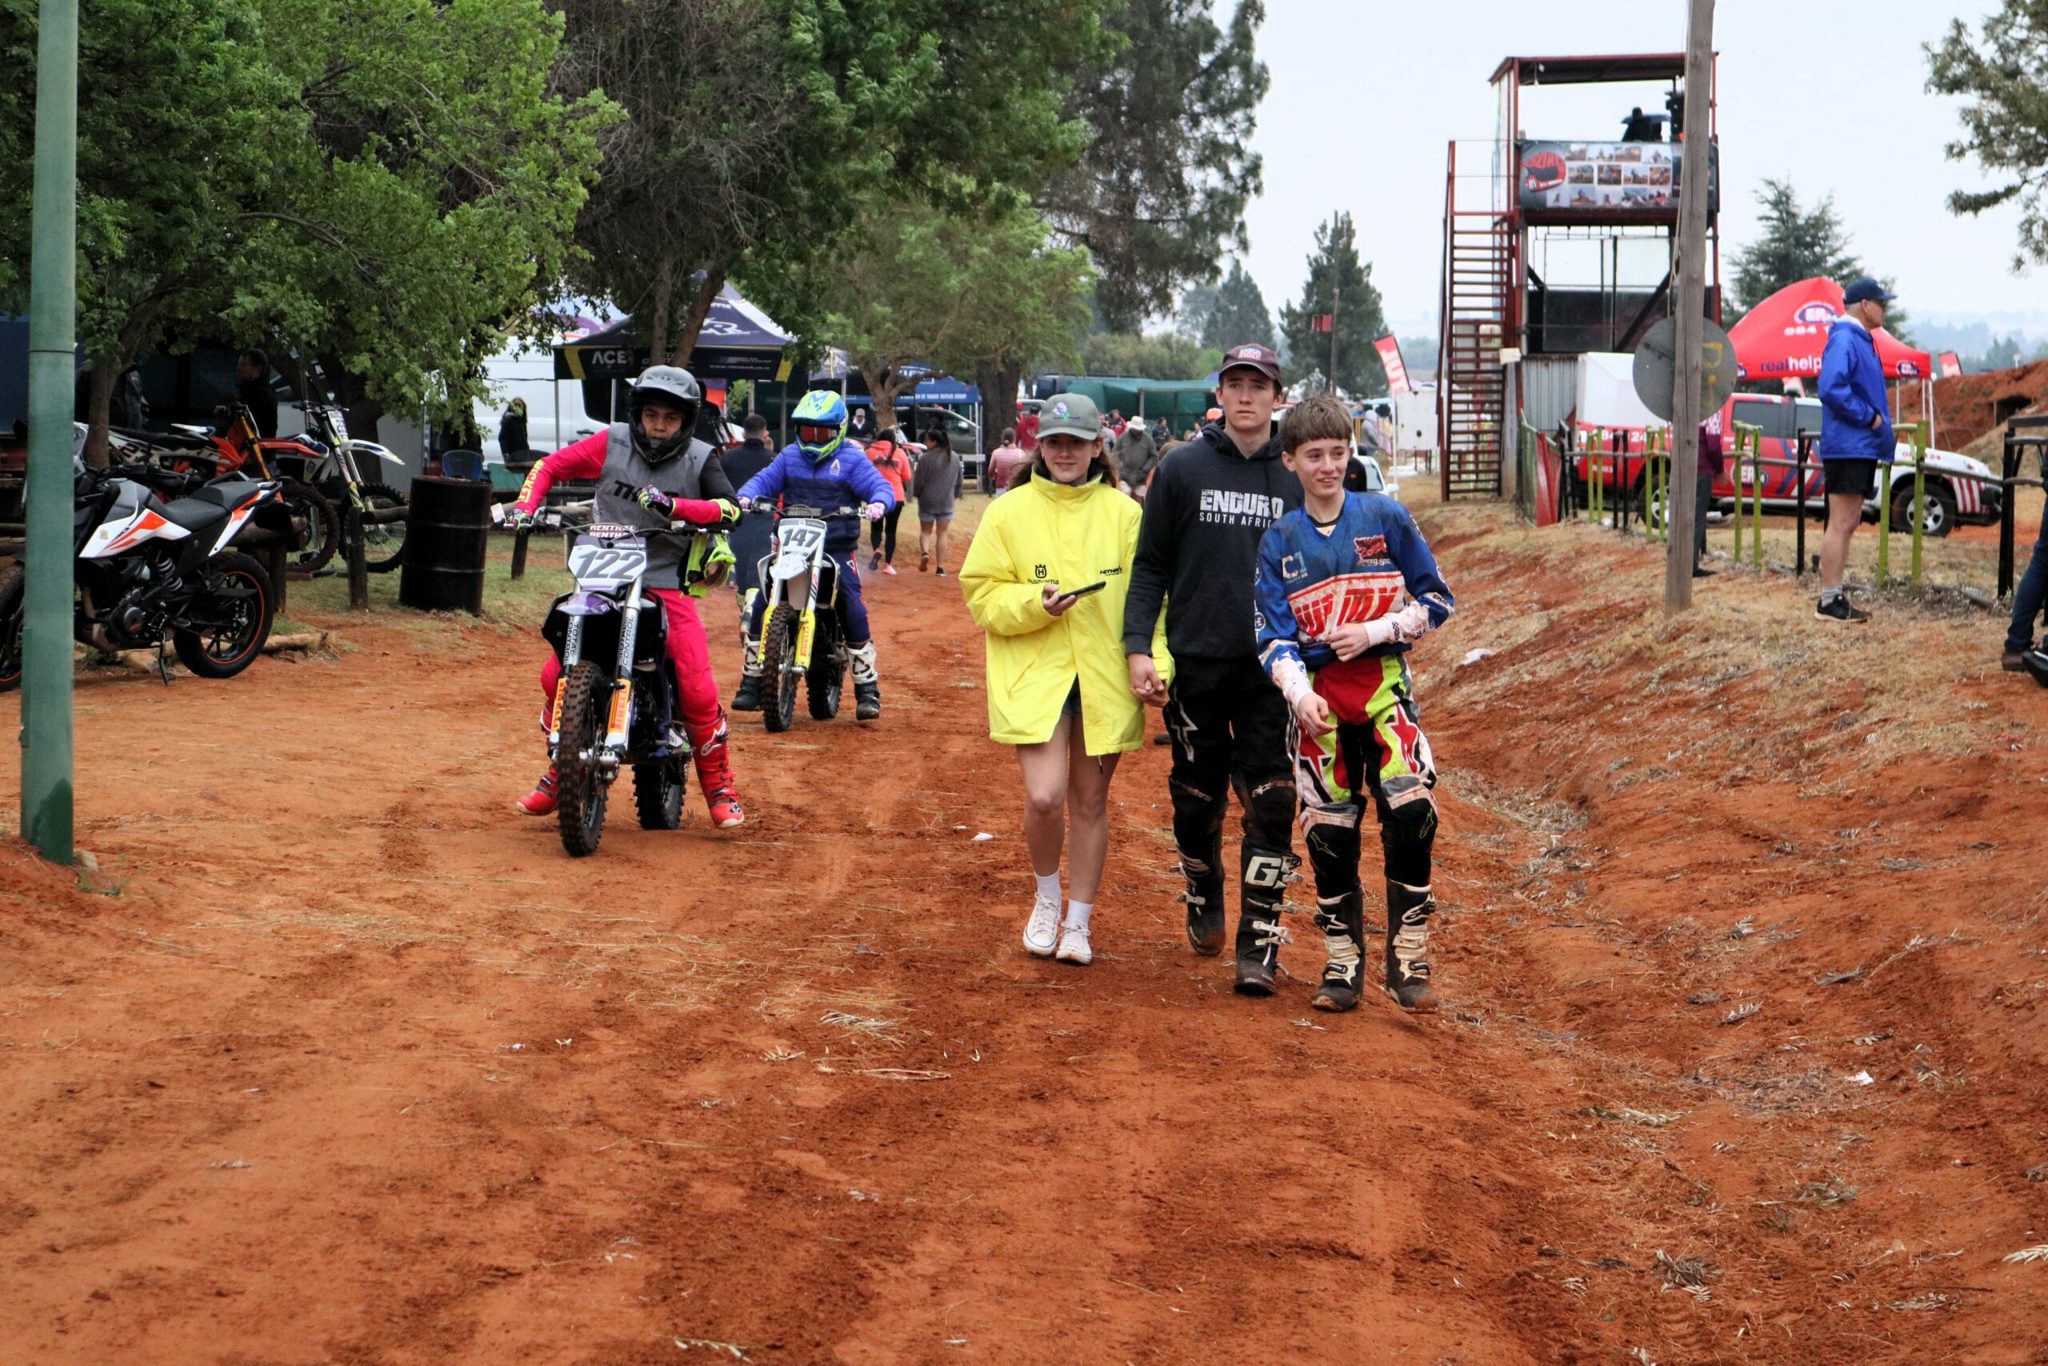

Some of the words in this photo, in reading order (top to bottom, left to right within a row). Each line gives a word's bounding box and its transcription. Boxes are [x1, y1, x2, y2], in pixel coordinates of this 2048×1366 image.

[591, 351, 628, 365] ACE
[1200, 488, 1284, 519] ENDURO
[1199, 512, 1235, 525] SOUTH
[783, 528, 822, 548] 147
[574, 550, 645, 580] 122
[623, 616, 634, 666] CONTROL
